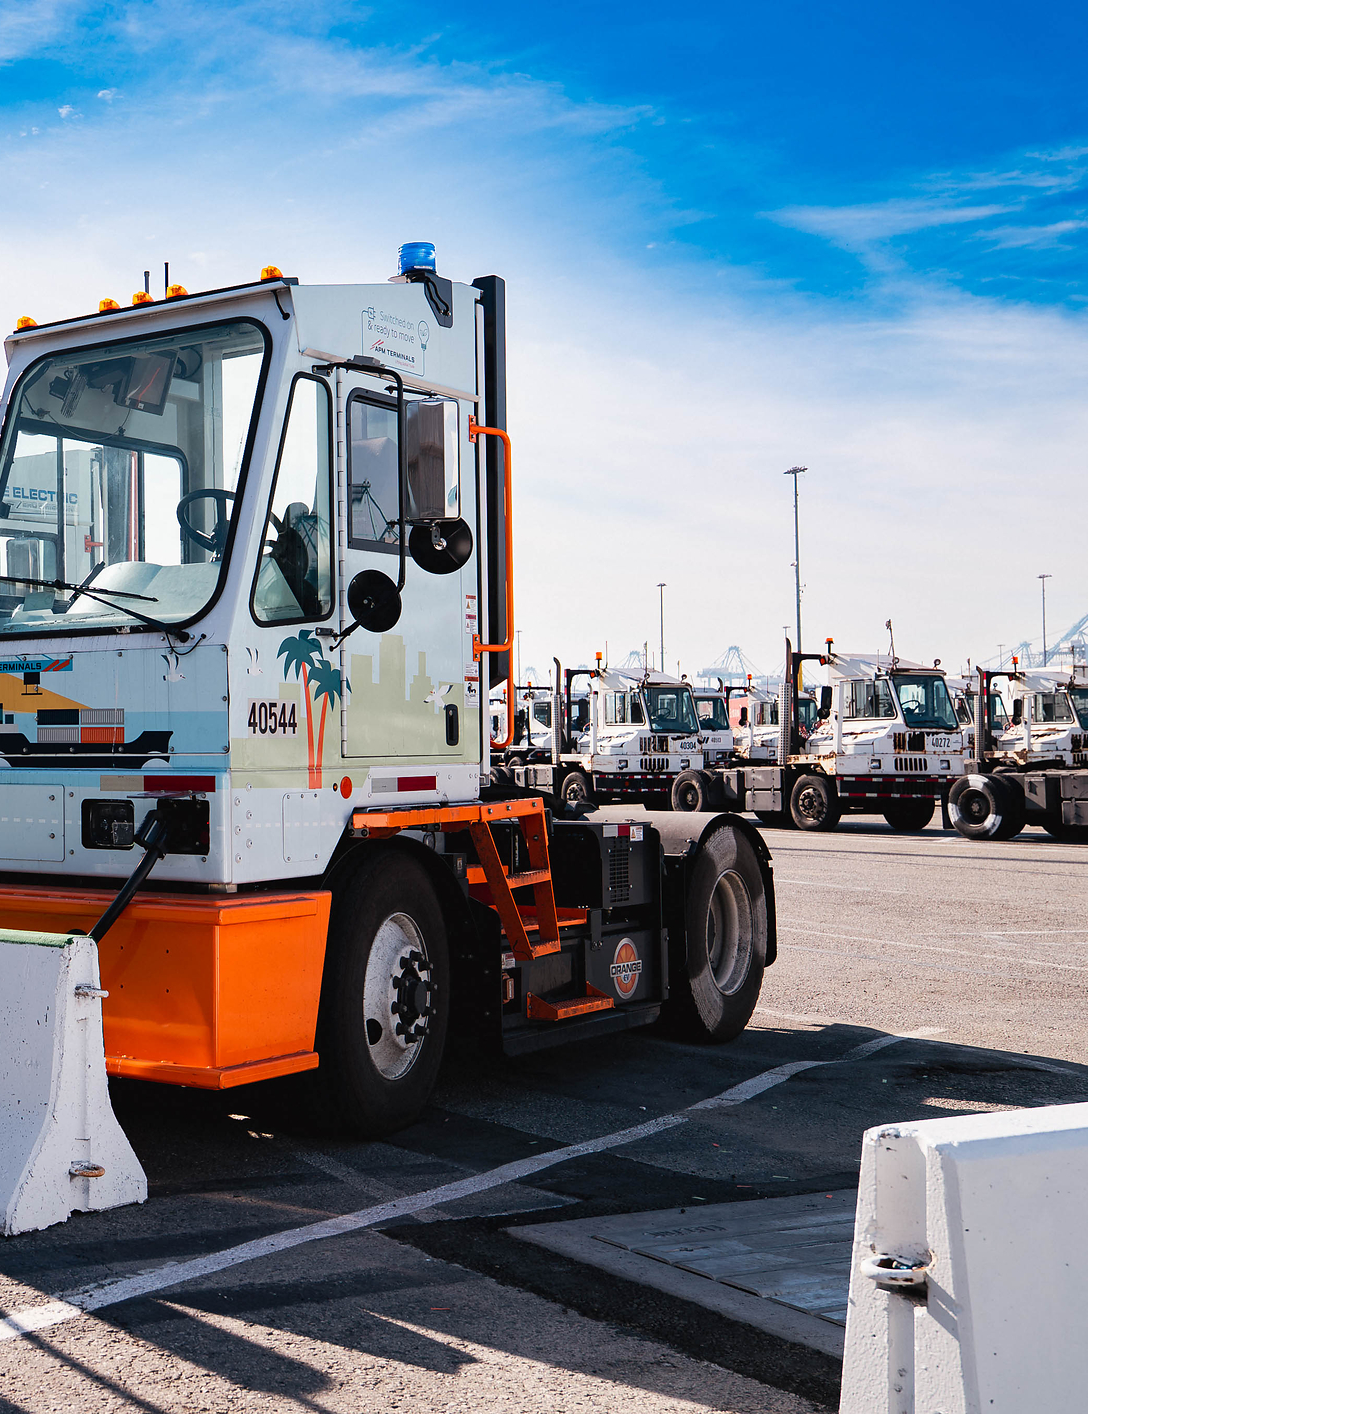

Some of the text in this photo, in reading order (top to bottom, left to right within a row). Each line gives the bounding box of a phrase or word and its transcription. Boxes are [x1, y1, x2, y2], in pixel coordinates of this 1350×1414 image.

[380, 311, 415, 330] Switched on
[368, 320, 415, 344] & ready to move
[375, 346, 415, 363] APM TERMINALS
[13, 487, 77, 504] ELECTIC
[247, 702, 298, 735] 40544
[680, 741, 696, 749] 40304
[931, 737, 951, 748] 40272
[611, 962, 641, 975] ORANGE
